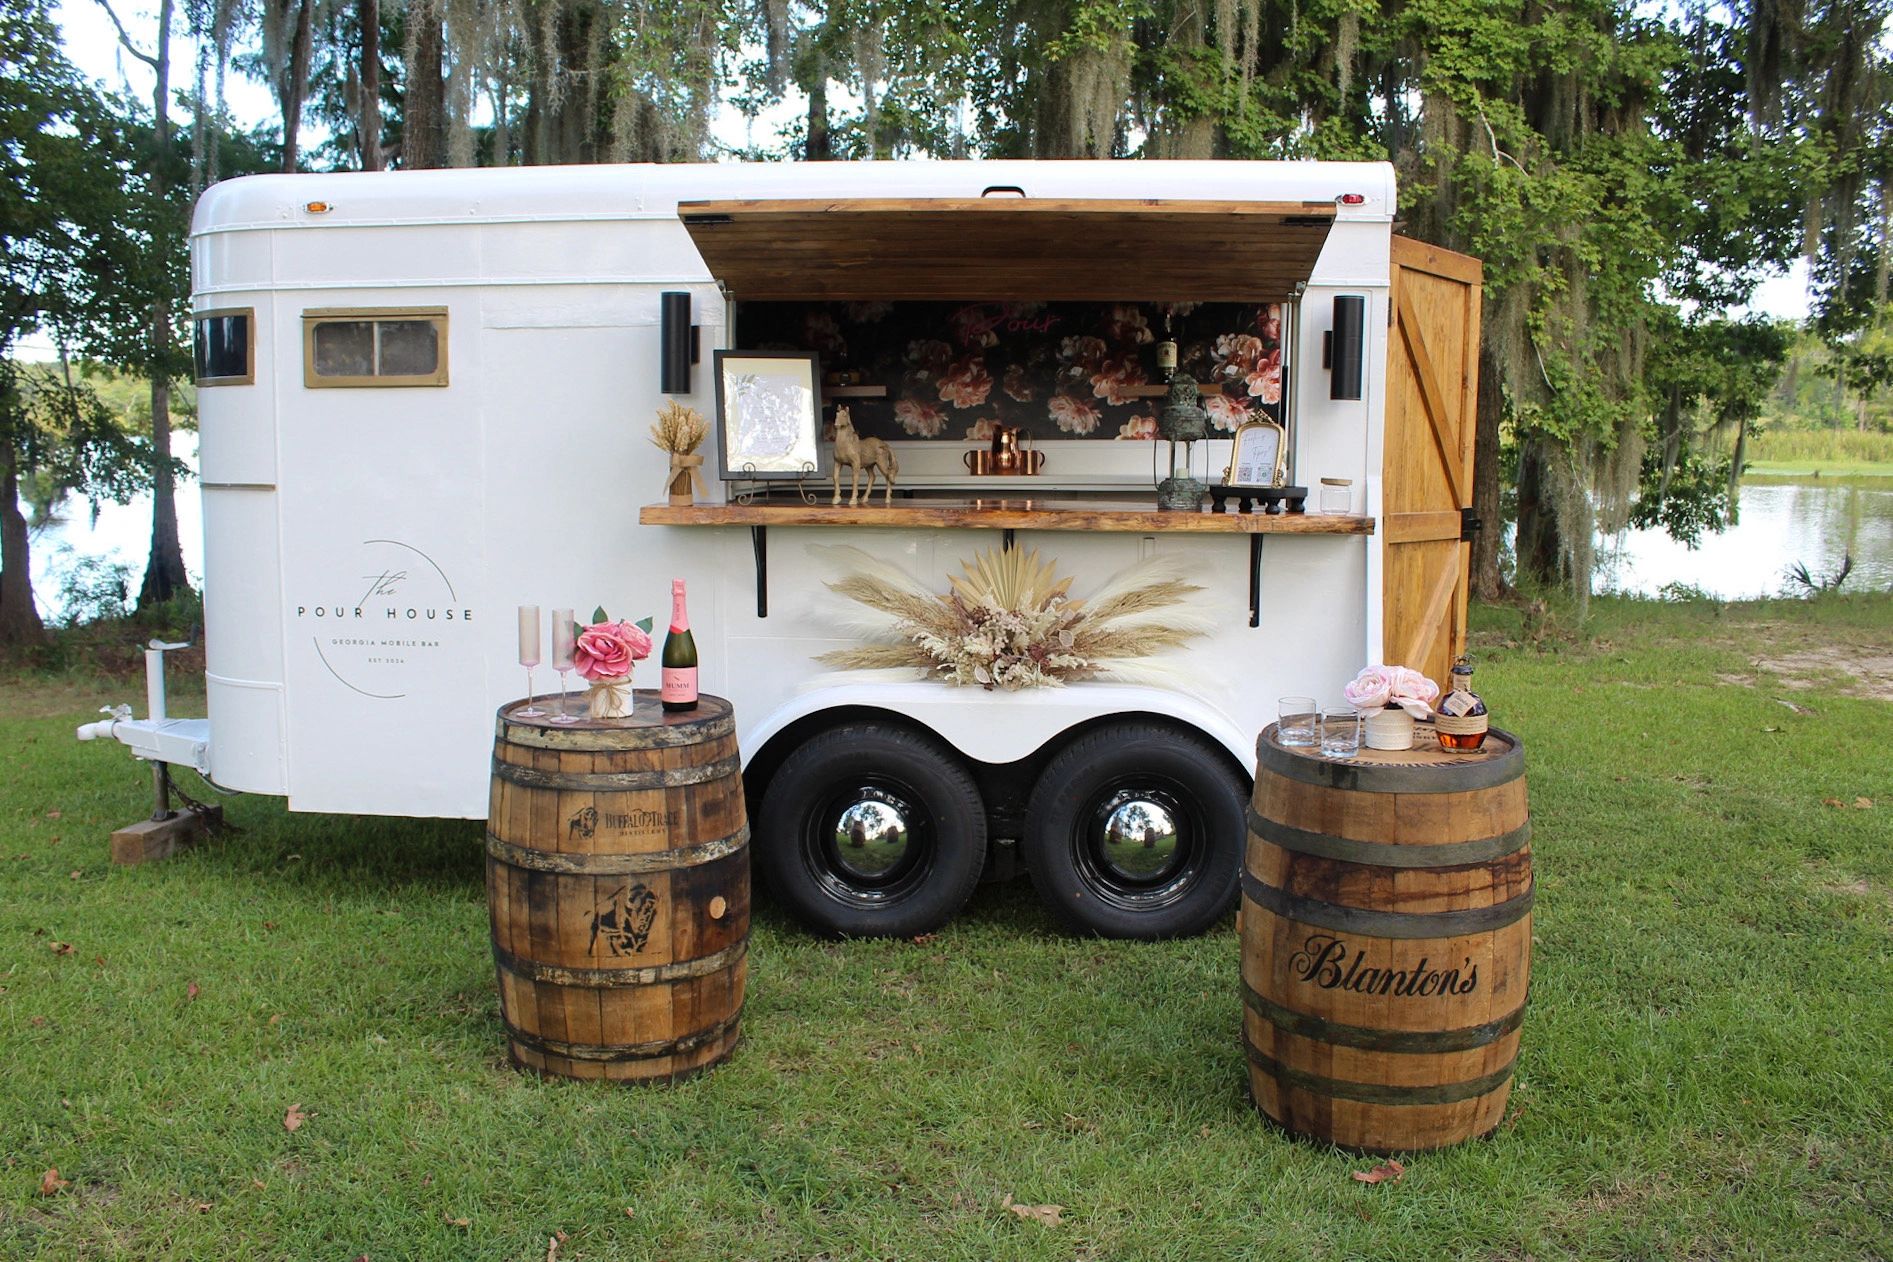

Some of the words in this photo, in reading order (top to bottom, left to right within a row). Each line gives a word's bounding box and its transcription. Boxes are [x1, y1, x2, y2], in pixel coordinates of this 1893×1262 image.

[359, 570, 407, 607] the
[298, 606, 363, 618] POUR
[387, 608, 472, 621] HOUSE
[331, 638, 375, 646] GEORGIA
[1288, 934, 1478, 998] Blanton's
